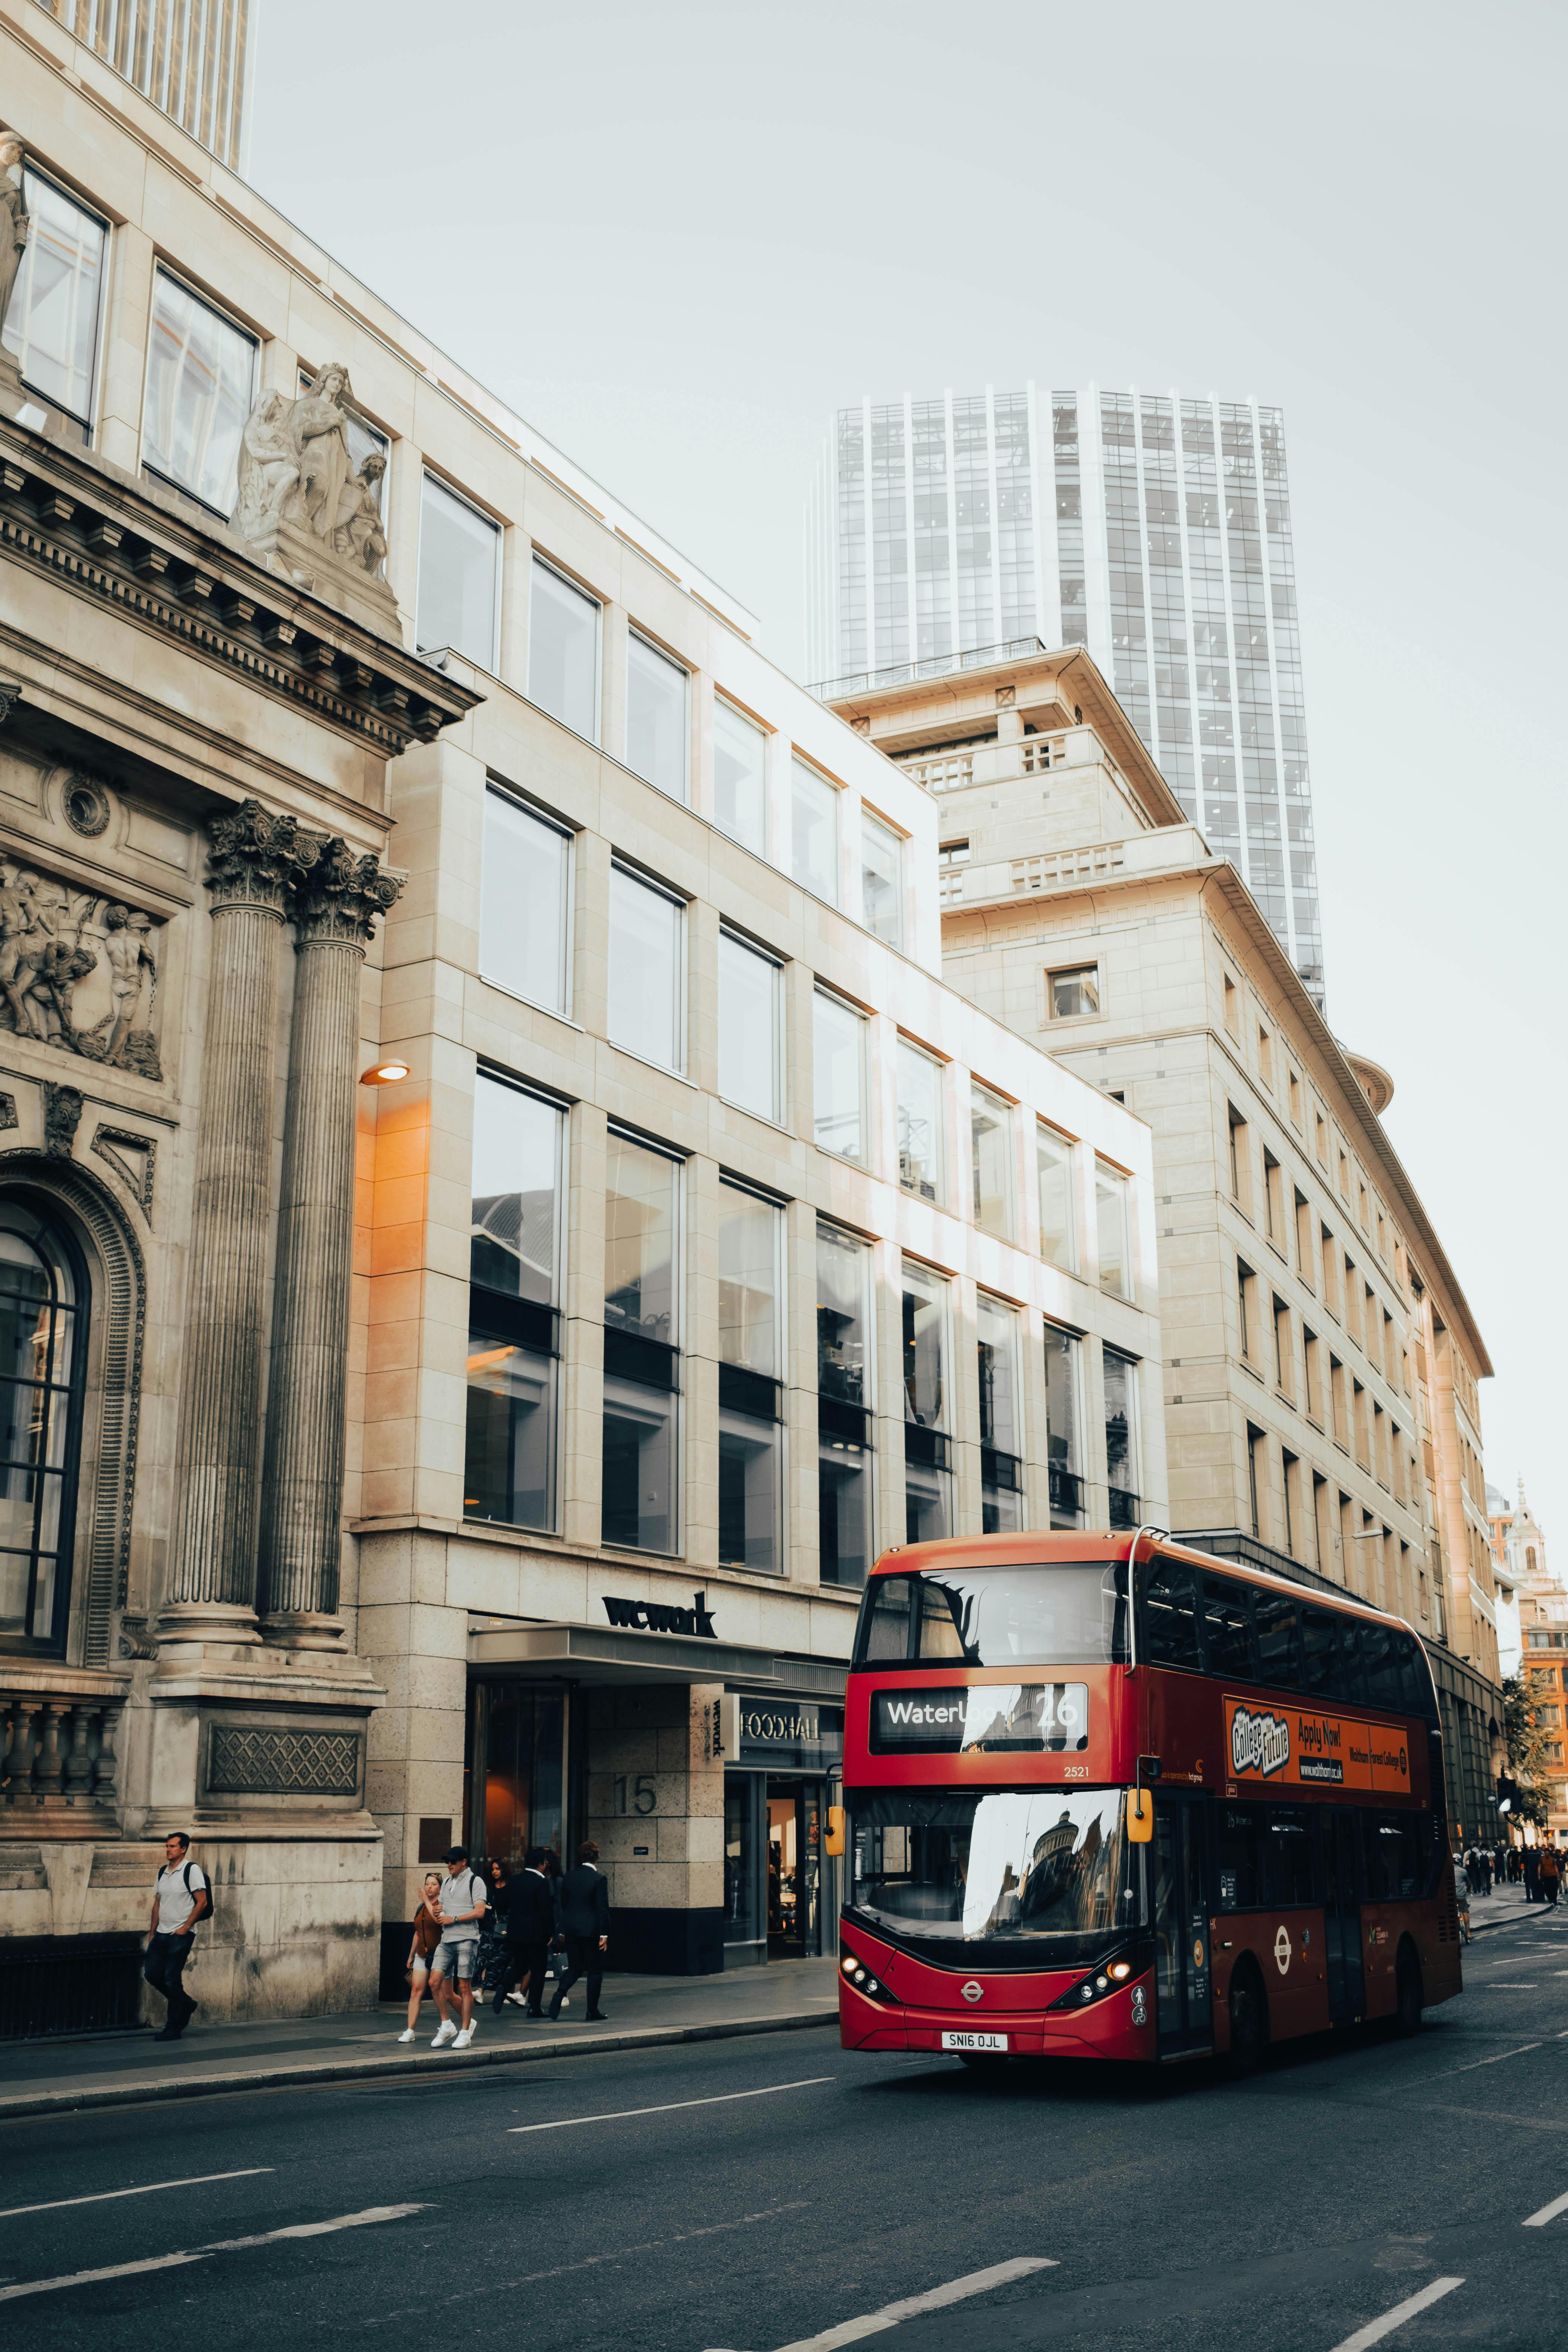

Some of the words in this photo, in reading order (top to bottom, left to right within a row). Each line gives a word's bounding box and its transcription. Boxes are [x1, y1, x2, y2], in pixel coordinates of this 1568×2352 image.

[601, 1591, 718, 1639] wework
[887, 1701, 997, 1724] Waterloo
[1036, 1692, 1078, 1727] 26
[713, 1698, 726, 1758] wework
[1234, 1721, 1262, 1764] College
[1298, 1717, 1322, 1752] Apply
[1322, 1720, 1341, 1748] Now!
[1263, 1729, 1287, 1767] Future
[1383, 1750, 1399, 1772] College
[1064, 1767, 1089, 1777] 2521
[615, 1775, 657, 1815] 15
[1210, 1918, 1217, 1930] HK
[949, 2034, 974, 2046] SN16
[978, 2035, 1000, 2048] OJL
